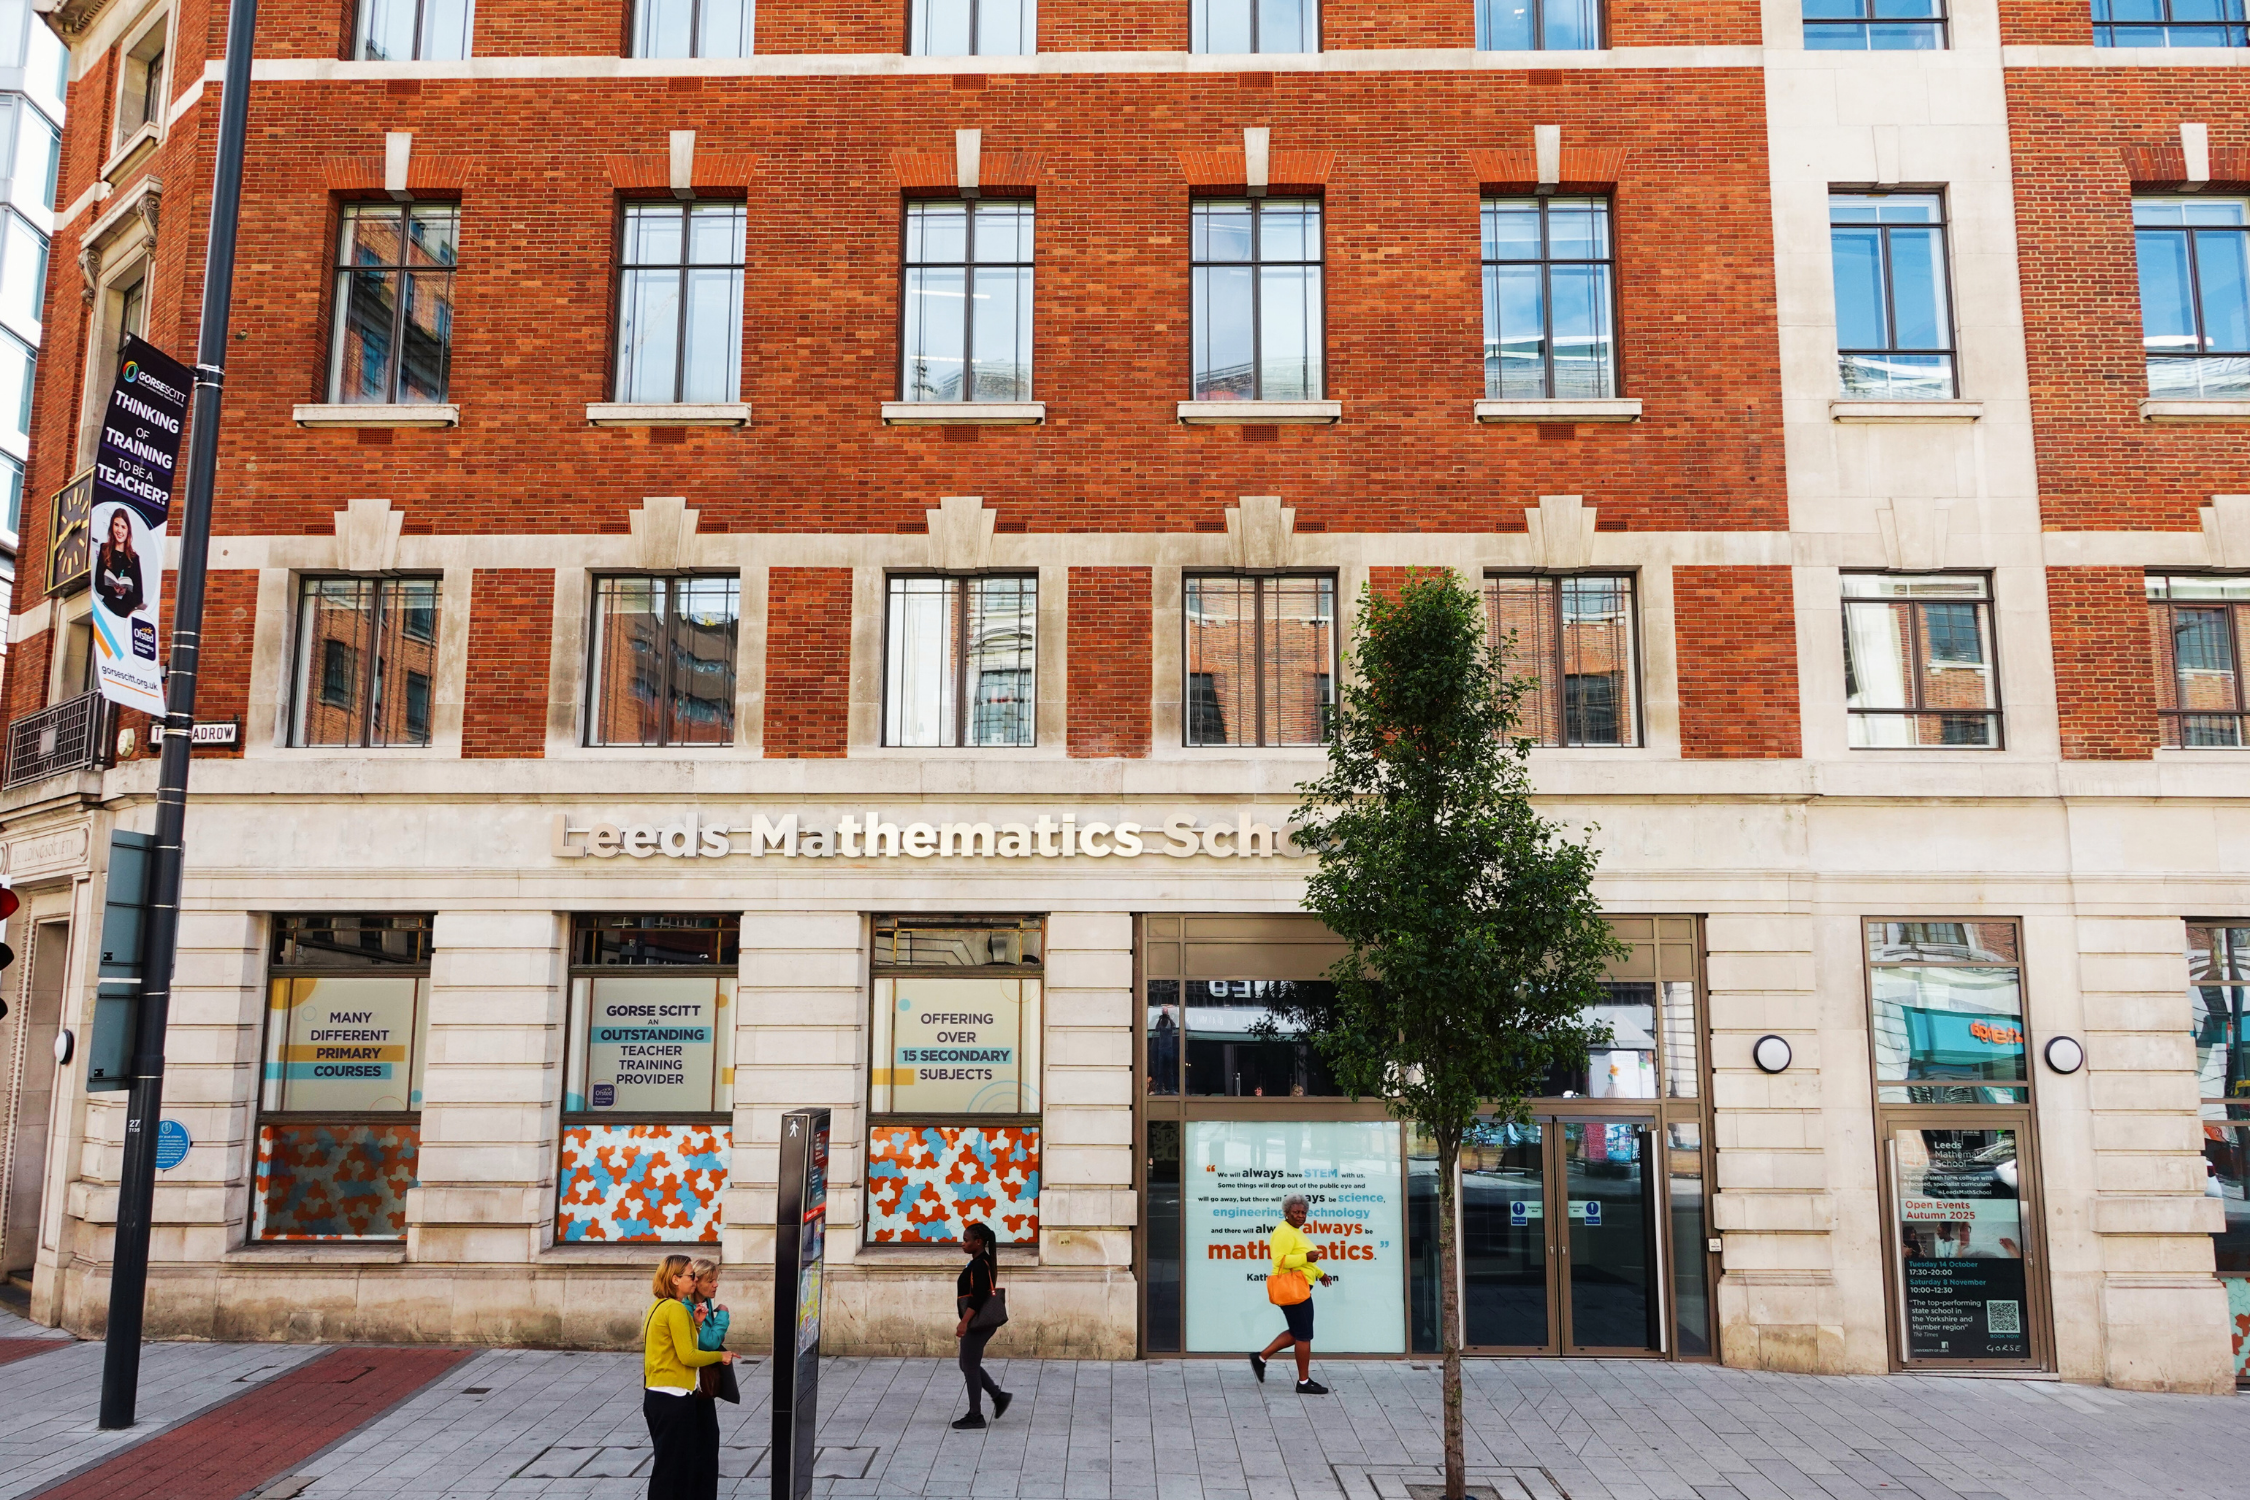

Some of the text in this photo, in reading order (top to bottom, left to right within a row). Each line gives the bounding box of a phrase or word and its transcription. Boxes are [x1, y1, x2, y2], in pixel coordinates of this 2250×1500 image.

[138, 371, 187, 403] GORSESCITT
[115, 389, 180, 434] THINKING
[135, 427, 151, 440] OF
[106, 426, 173, 469] TRAINING
[118, 457, 154, 482] TO BE A
[97, 462, 169, 505] TEACHER?
[133, 628, 154, 643] Ofsted
[101, 665, 158, 691] gorsescitt.org.uk
[551, 810, 1348, 858] Leeds Mathematics Scho
[606, 1005, 701, 1016] GORSE SCITT
[329, 1011, 373, 1023] MANY
[920, 1013, 994, 1024] OFFERING
[310, 1029, 390, 1041] DIFFERENT
[600, 1029, 705, 1041] OUTSTANDING
[936, 1031, 976, 1043] OVER
[316, 1047, 382, 1059] PRIMARY
[620, 1045, 683, 1056] TEACHER
[902, 1050, 1010, 1062] 15 SECONDARY
[618, 1059, 683, 1070] TRAINING
[313, 1065, 382, 1077] COURSES
[919, 1069, 993, 1080] SUBJECTS
[616, 1074, 684, 1084] PROVIDER
[128, 1119, 141, 1128] 27
[1934, 1140, 1962, 1149] Leeds
[1934, 1150, 1993, 1159] Mathematics
[1935, 1159, 1967, 1168] School
[1242, 1168, 1284, 1180] always
[1304, 1168, 1338, 1178] STEM
[1338, 1192, 1386, 1204] science,
[1905, 1200, 1971, 1210] Open Events
[1307, 1207, 1371, 1219] echnology
[1906, 1211, 1976, 1220] Autumn 2025
[1302, 1220, 1363, 1237] always
[1208, 1240, 1377, 1260] mathatics.
[1908, 1260, 1938, 1268] Tuesday
[1948, 1260, 1978, 1268] October
[1909, 1278, 1941, 1286] Saturday
[1927, 1299, 1982, 1308] top-performing
[1942, 1323, 1969, 1331] region"
[1986, 1344, 2022, 1352] GORSE
